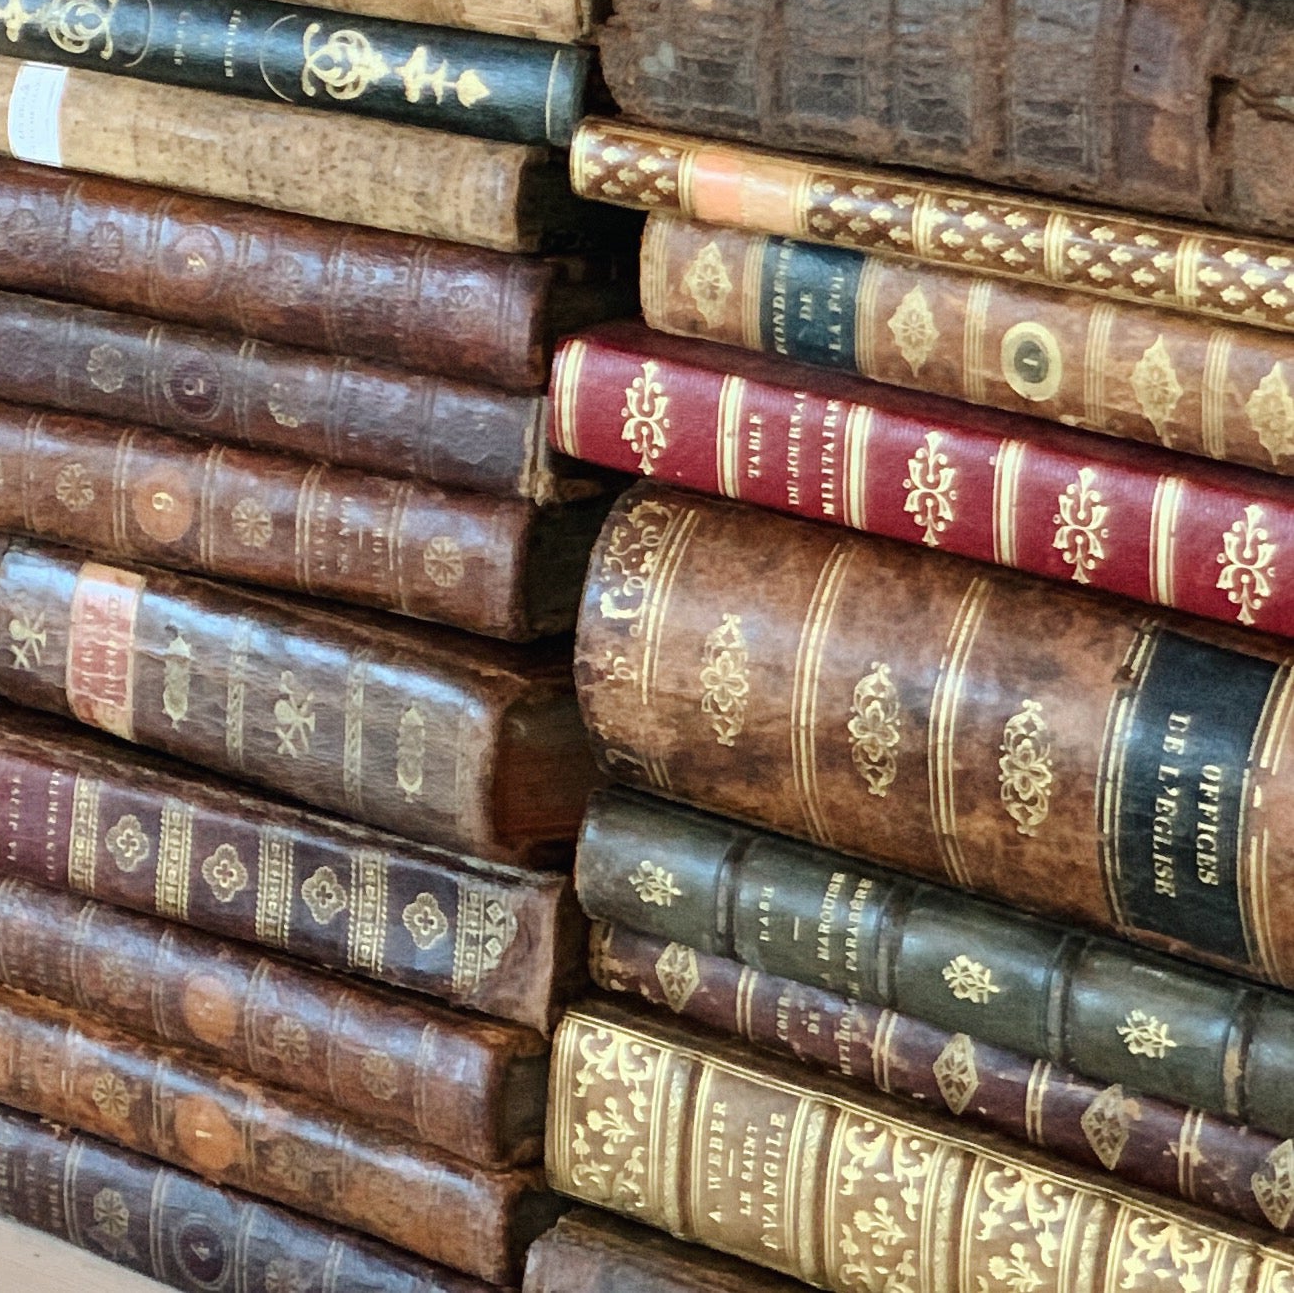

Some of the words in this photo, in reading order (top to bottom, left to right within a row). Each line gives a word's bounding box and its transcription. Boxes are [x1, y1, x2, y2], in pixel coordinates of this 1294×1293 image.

[799, 292, 814, 323] DE
[826, 323, 843, 352] LA
[747, 412, 762, 479] TABLE
[787, 391, 808, 479] JOURNAL
[821, 398, 841, 516] MILITAIRE
[787, 480, 801, 506] DU
[1162, 711, 1192, 756] DE
[1196, 764, 1222, 886] OFFICES
[759, 885, 775, 942] DASH
[817, 871, 847, 962] MARQUISE
[807, 1010, 821, 1035] DE
[834, 997, 859, 1077] MYTHOL
[707, 1101, 727, 1191] WEBER
[740, 1121, 759, 1183] SAINT
[707, 1204, 722, 1224] A.
[739, 1190, 752, 1217] LE
